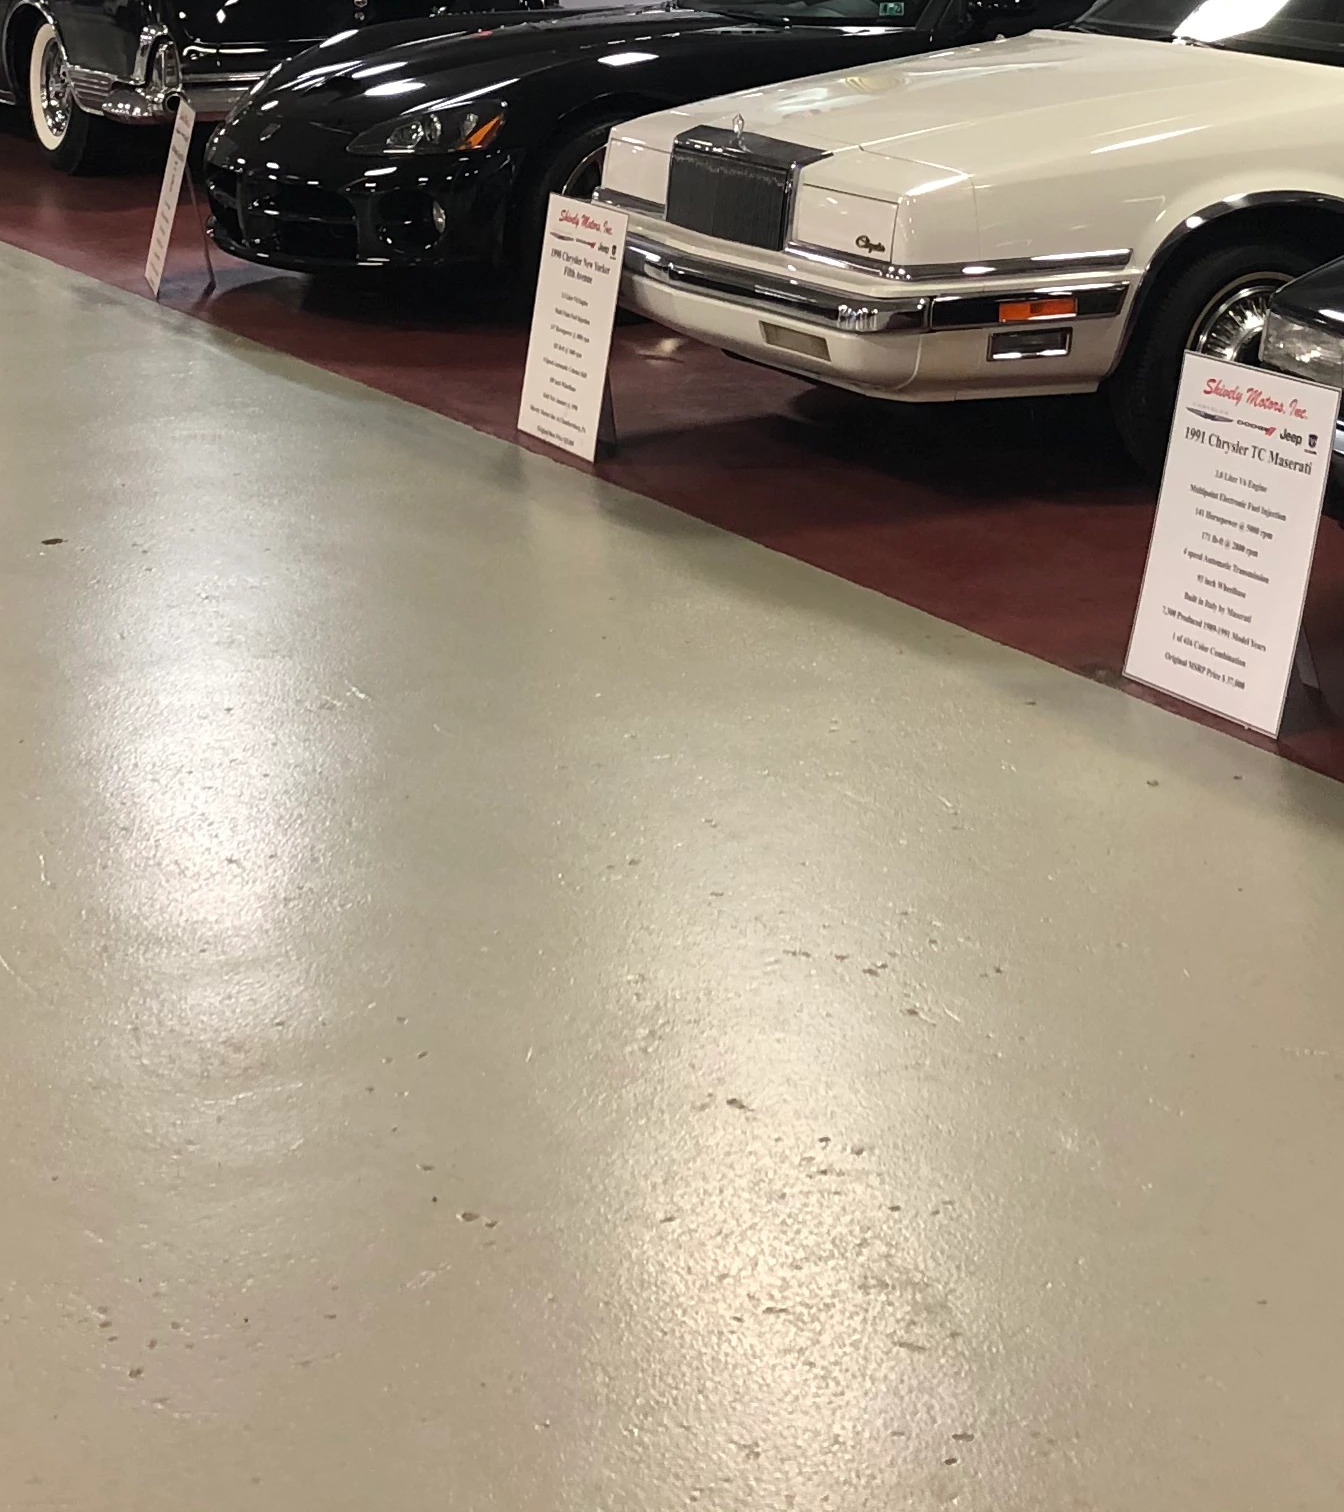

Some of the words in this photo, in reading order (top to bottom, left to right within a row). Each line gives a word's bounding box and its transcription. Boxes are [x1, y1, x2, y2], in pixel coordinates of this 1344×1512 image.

[562, 251, 582, 267] Chrysler
[1202, 378, 1243, 406] Shively
[1184, 426, 1206, 444] 1991
[1208, 432, 1249, 456] Chrysler
[1251, 444, 1267, 461] TC
[1268, 450, 1313, 476] Maserati
[1279, 428, 1303, 447] Jeep
[1224, 470, 1238, 484] Liter
[1247, 479, 1268, 493] Engine
[1219, 492, 1246, 509] Electronic
[1247, 501, 1261, 513] Fuel
[1261, 506, 1287, 522] Injection
[1205, 510, 1238, 528] Horsepower
[1260, 530, 1273, 540] rpm
[1246, 547, 1258, 558] rpm
[1204, 554, 1232, 571] Automatic
[1232, 564, 1269, 584] Transmission
[1217, 580, 1247, 599] Wheelbase
[1204, 599, 1218, 613] Italy
[1218, 604, 1226, 616] by
[1227, 607, 1252, 624] Maserati
[1176, 611, 1203, 628] Produced
[1231, 631, 1250, 646] Model
[1250, 638, 1267, 652] Years
[1176, 634, 1184, 643] of
[1193, 640, 1209, 653] Color
[1209, 647, 1246, 668] Combination
[1164, 651, 1188, 668] Original
[1206, 668, 1221, 681] Price
